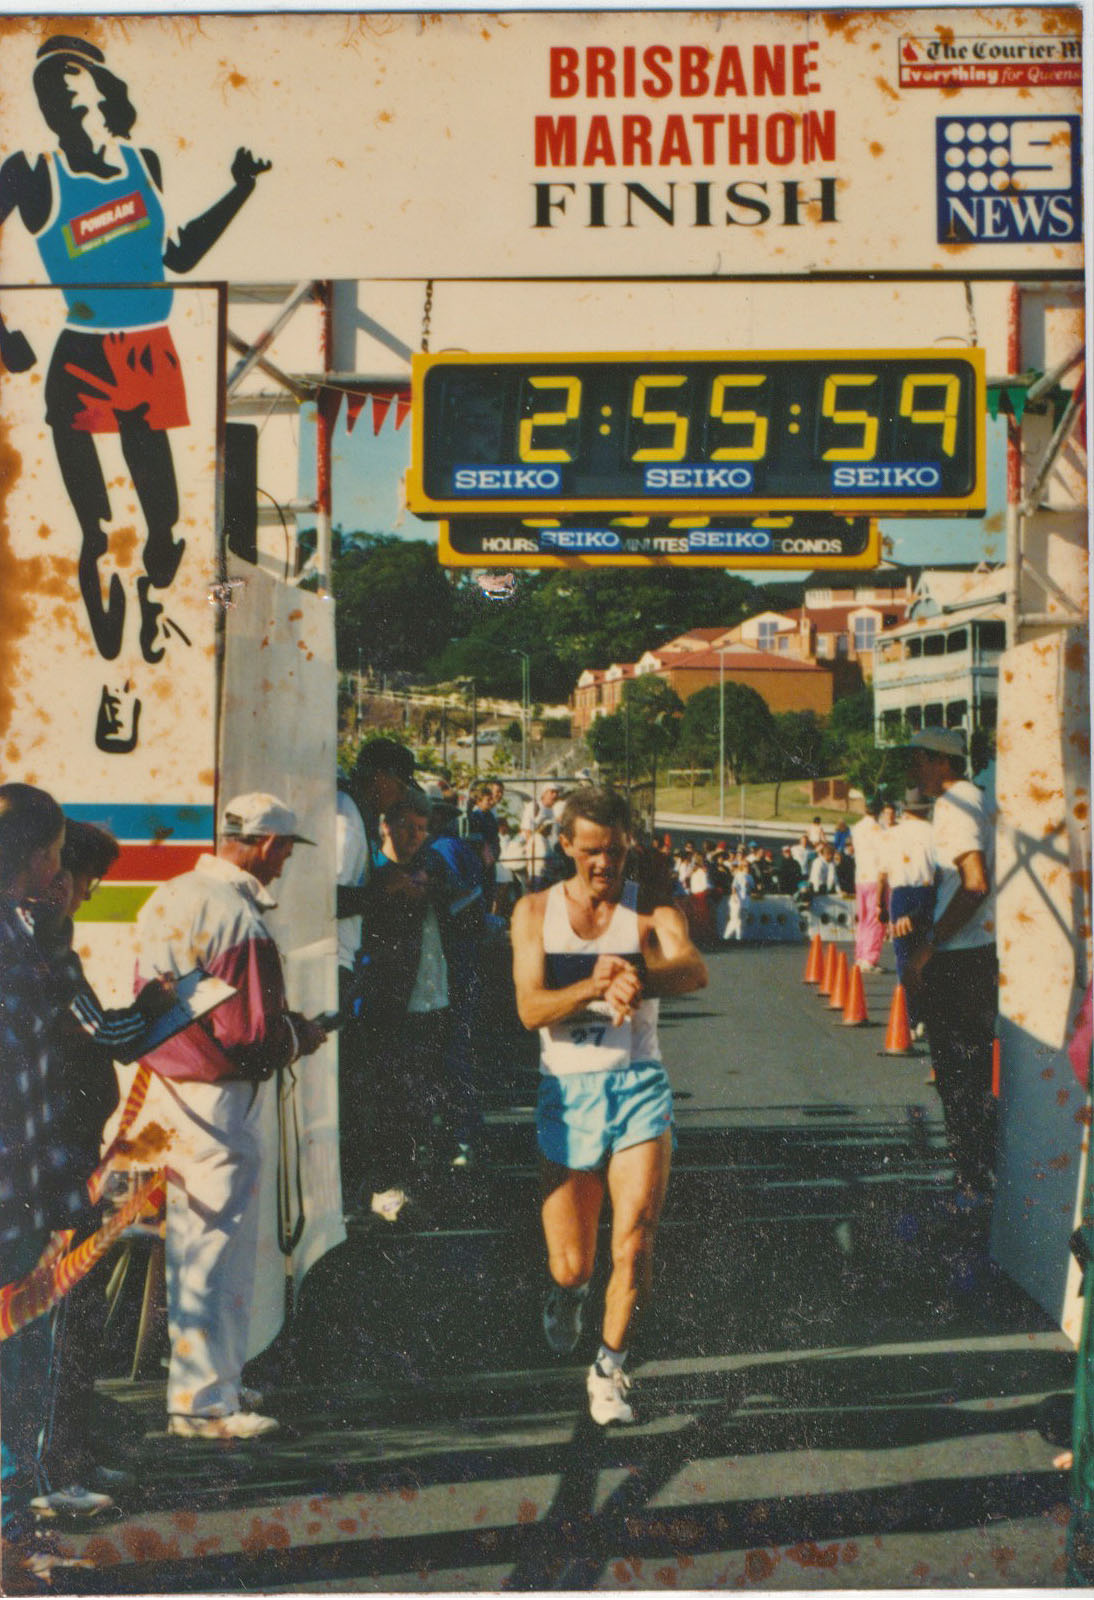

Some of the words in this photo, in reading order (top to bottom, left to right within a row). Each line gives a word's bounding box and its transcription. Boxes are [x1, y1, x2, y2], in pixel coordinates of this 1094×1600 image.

[926, 40, 968, 60] The
[549, 42, 821, 98] BRISBANE
[900, 65, 999, 86] Everything
[1000, 66, 1024, 84] for
[534, 110, 836, 168] MARATHON
[529, 177, 840, 228] FINISH
[945, 195, 1075, 238] NEWS
[518, 373, 961, 463] 2:55:59
[454, 469, 560, 490] SEIKO
[645, 468, 752, 488] SEIKO
[833, 466, 940, 487] SEIKO
[481, 537, 539, 552] HOURS
[541, 531, 620, 548] SEIKO
[689, 531, 770, 548] SEIKO
